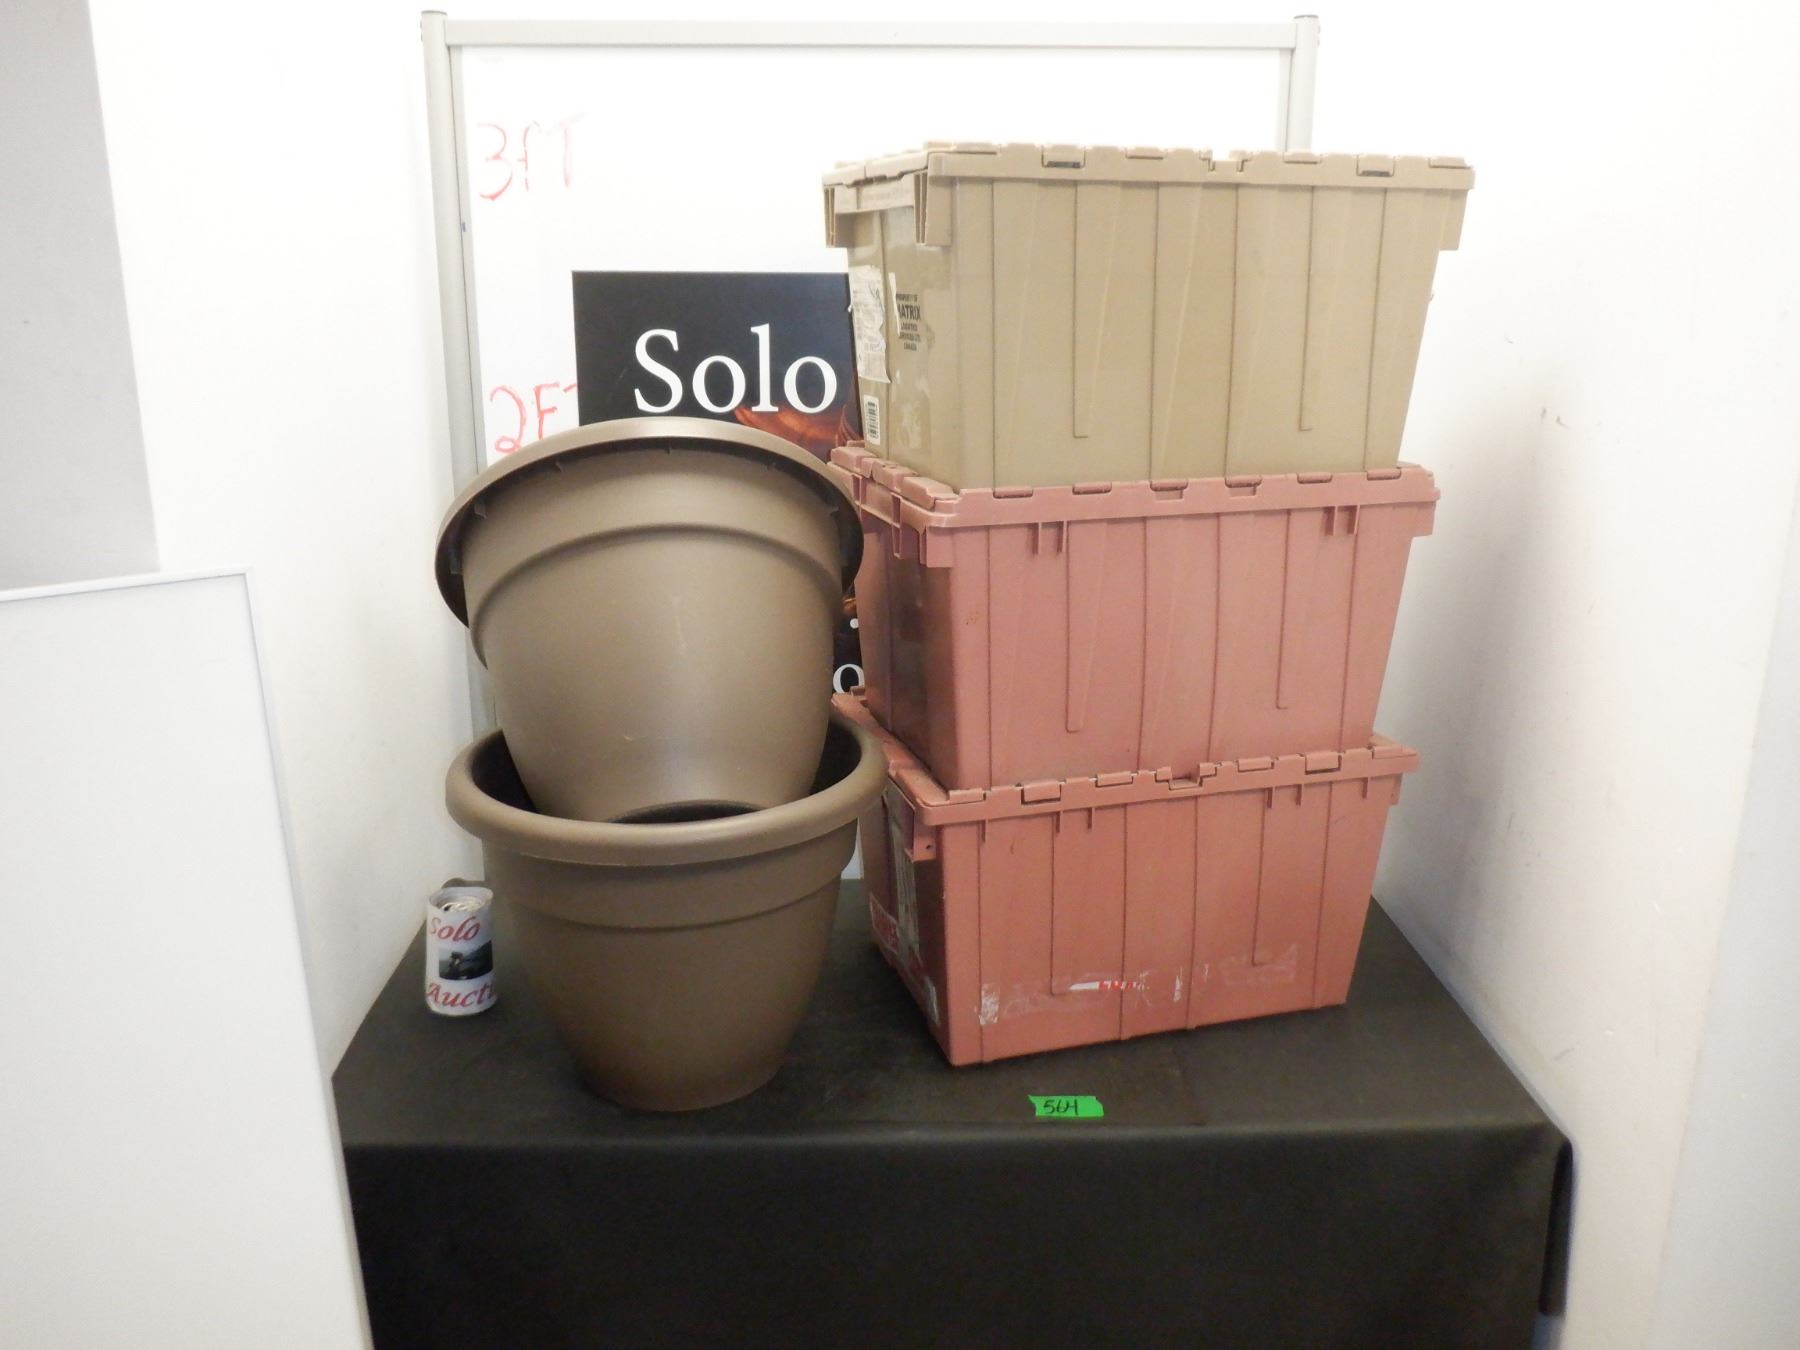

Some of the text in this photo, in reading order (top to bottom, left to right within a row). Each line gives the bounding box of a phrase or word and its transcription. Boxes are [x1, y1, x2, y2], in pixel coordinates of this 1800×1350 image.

[634, 323, 837, 414] Solo
[490, 381, 578, 454] 2F
[429, 916, 481, 941] Solo
